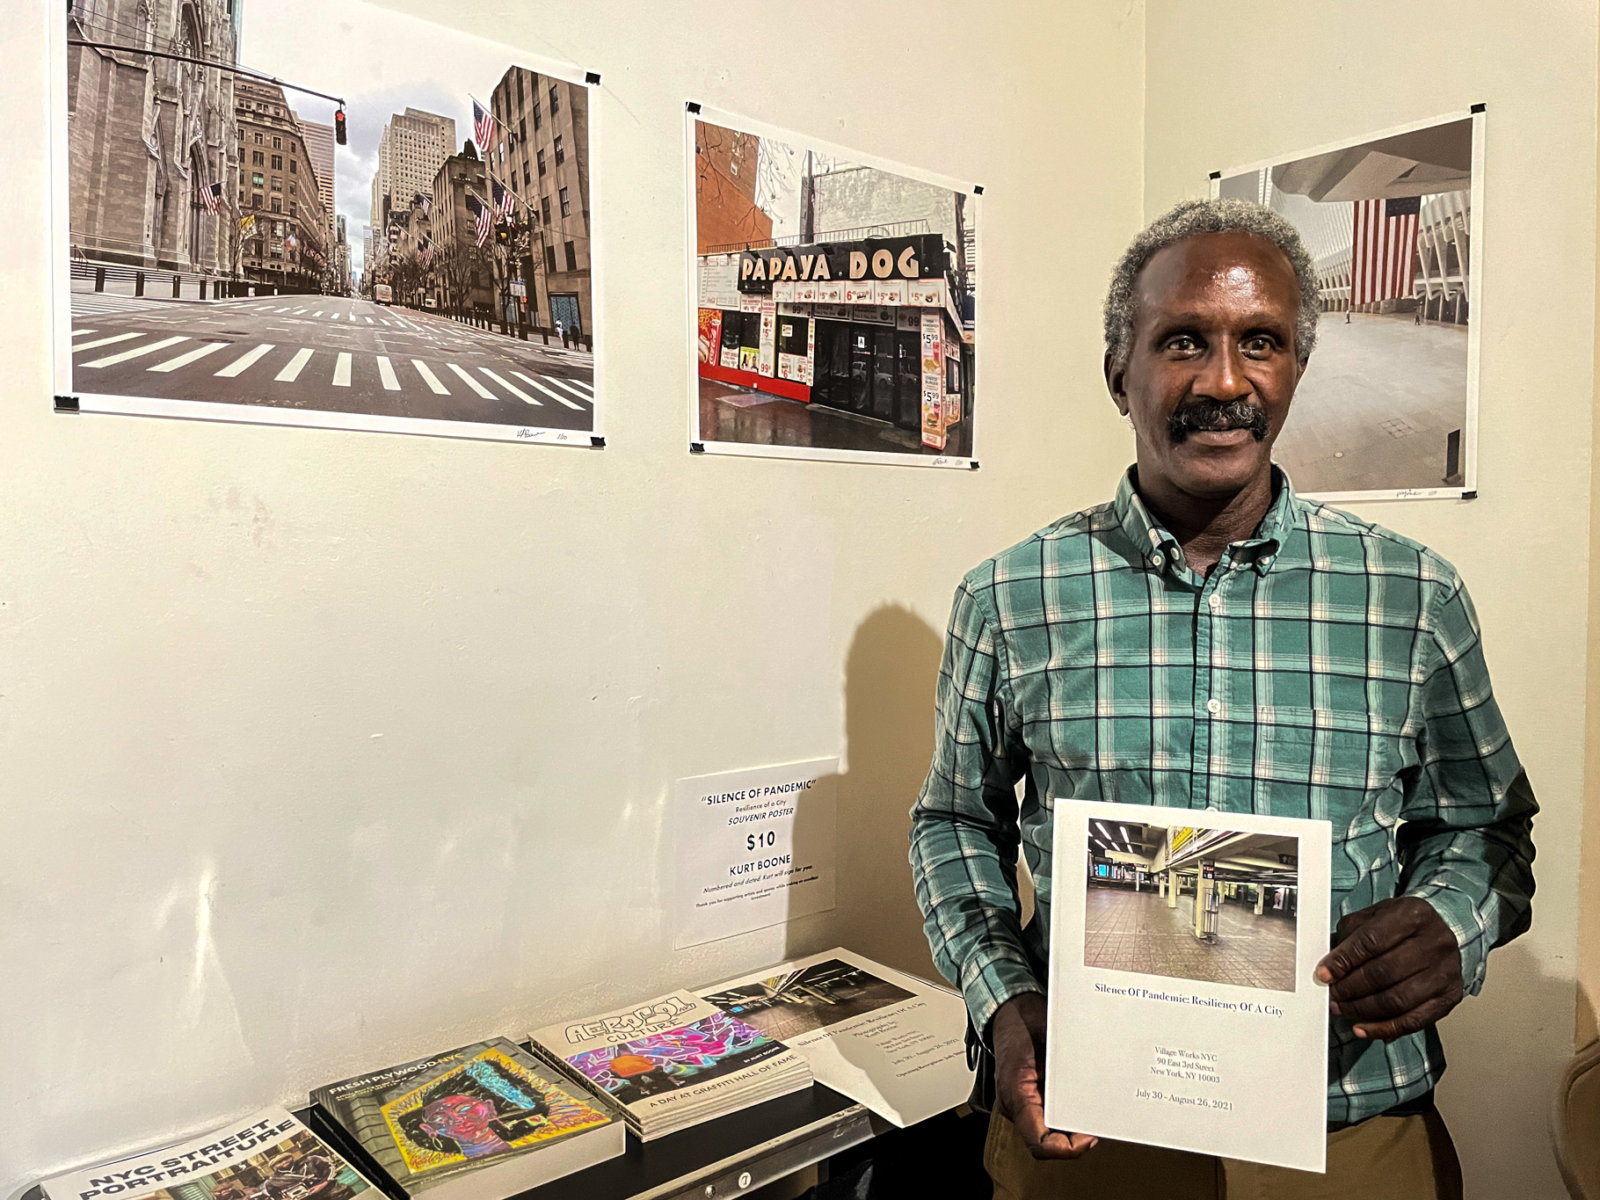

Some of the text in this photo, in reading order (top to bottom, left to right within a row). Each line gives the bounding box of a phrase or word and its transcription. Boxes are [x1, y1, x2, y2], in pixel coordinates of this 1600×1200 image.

[741, 246, 919, 281] PAPAYA DOG
[748, 788, 762, 799] OF
[728, 808, 794, 825] SOUVENIR POSTER
[736, 804, 762, 812] Resilience
[747, 830, 776, 851] $10
[730, 854, 791, 876] KURT BOONE
[703, 882, 733, 894] Numbered
[774, 870, 784, 878] will
[1094, 983, 1284, 1018] Silence Of Pandemic: Resiliency Of A City
[606, 1018, 684, 1043] CULTURE
[1154, 1046, 1218, 1062] Village Works NYC
[1156, 1057, 1215, 1072] 90 East 3rd Street
[328, 1078, 371, 1094] FRESH
[372, 1061, 436, 1082] PLYWOOD
[438, 1053, 464, 1064] NYC
[658, 1096, 677, 1104] DAY
[693, 1079, 735, 1095] GRAFFITI
[736, 1071, 758, 1082] HALL
[758, 1065, 772, 1073] OF
[772, 1054, 798, 1068] FAME
[1150, 1066, 1165, 1075] New
[1185, 1072, 1197, 1080] NY
[1198, 1074, 1220, 1084] 10003
[1136, 1088, 1152, 1100] July
[1152, 1090, 1163, 1100] 30
[1168, 1094, 1196, 1105] August
[1212, 1100, 1233, 1111] 2021
[79, 1119, 296, 1200] PORTRAITURE
[90, 1118, 270, 1188] NYC STREET
